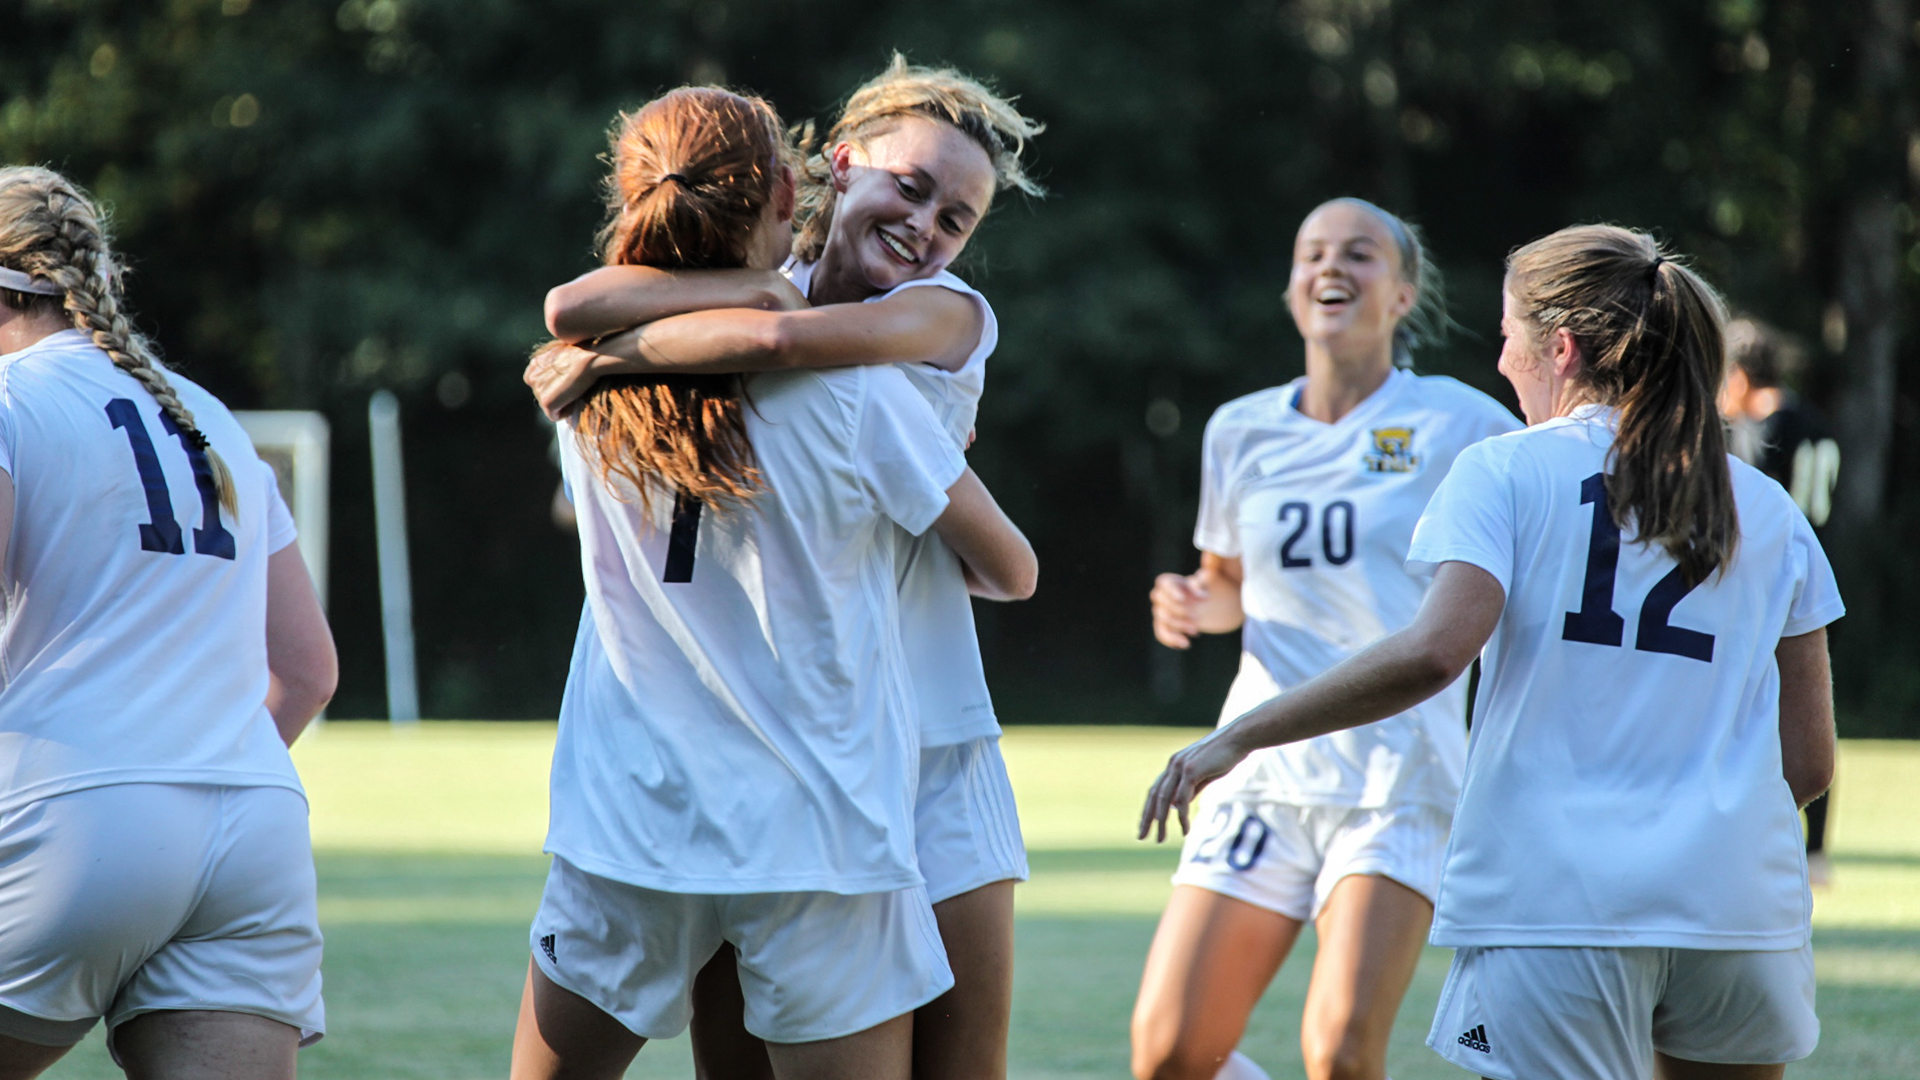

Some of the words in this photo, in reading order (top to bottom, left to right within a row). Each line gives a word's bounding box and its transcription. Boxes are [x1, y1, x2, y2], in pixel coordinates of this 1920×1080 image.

[104, 398, 237, 560] 11
[1278, 500, 1355, 568] 20
[1561, 472, 1716, 663] 12
[1190, 803, 1271, 871] 20
[1457, 1036, 1491, 1054] adidas
